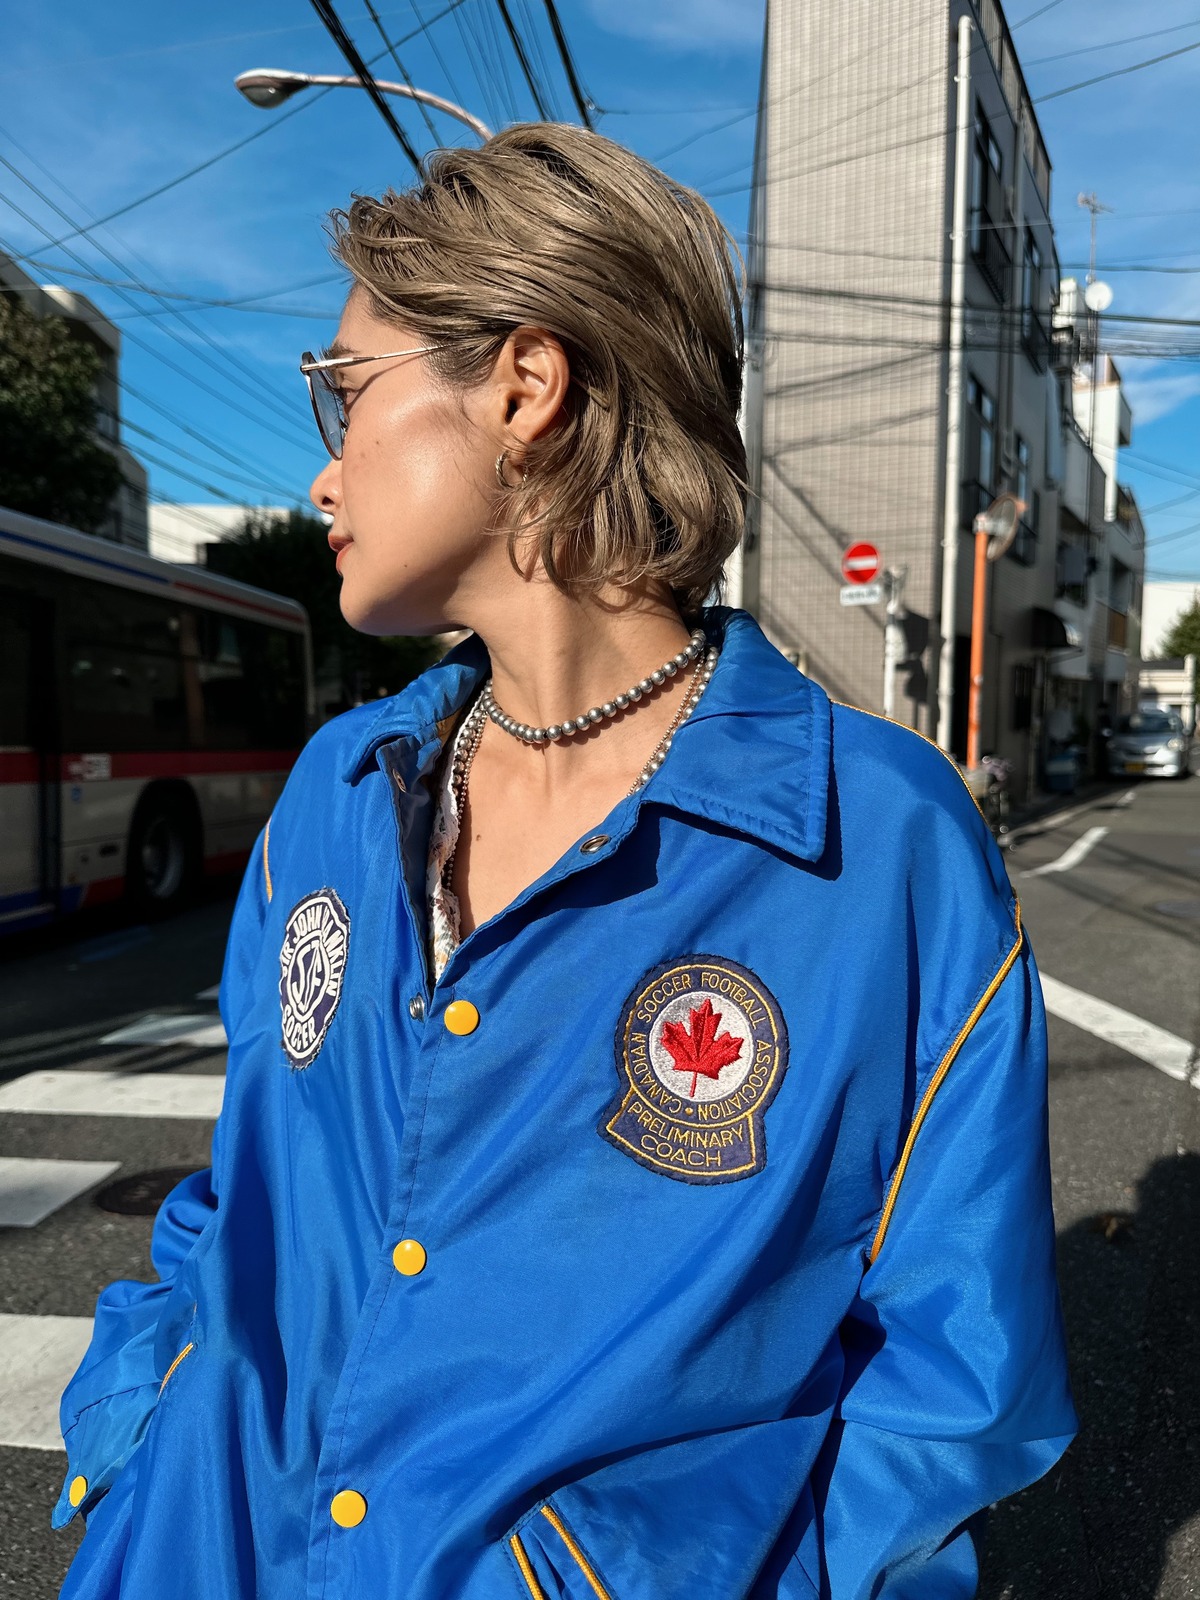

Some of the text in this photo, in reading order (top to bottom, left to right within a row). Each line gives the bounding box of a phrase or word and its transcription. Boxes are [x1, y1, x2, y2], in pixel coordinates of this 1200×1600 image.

[293, 904, 322, 944] JOHN
[282, 1003, 317, 1051] SOCCER
[630, 971, 773, 1121] CANADIAN SOCCER FOOTBALL ASSOCIATION
[627, 1101, 744, 1149] PRELIMINARY
[640, 1134, 722, 1167] COACH
